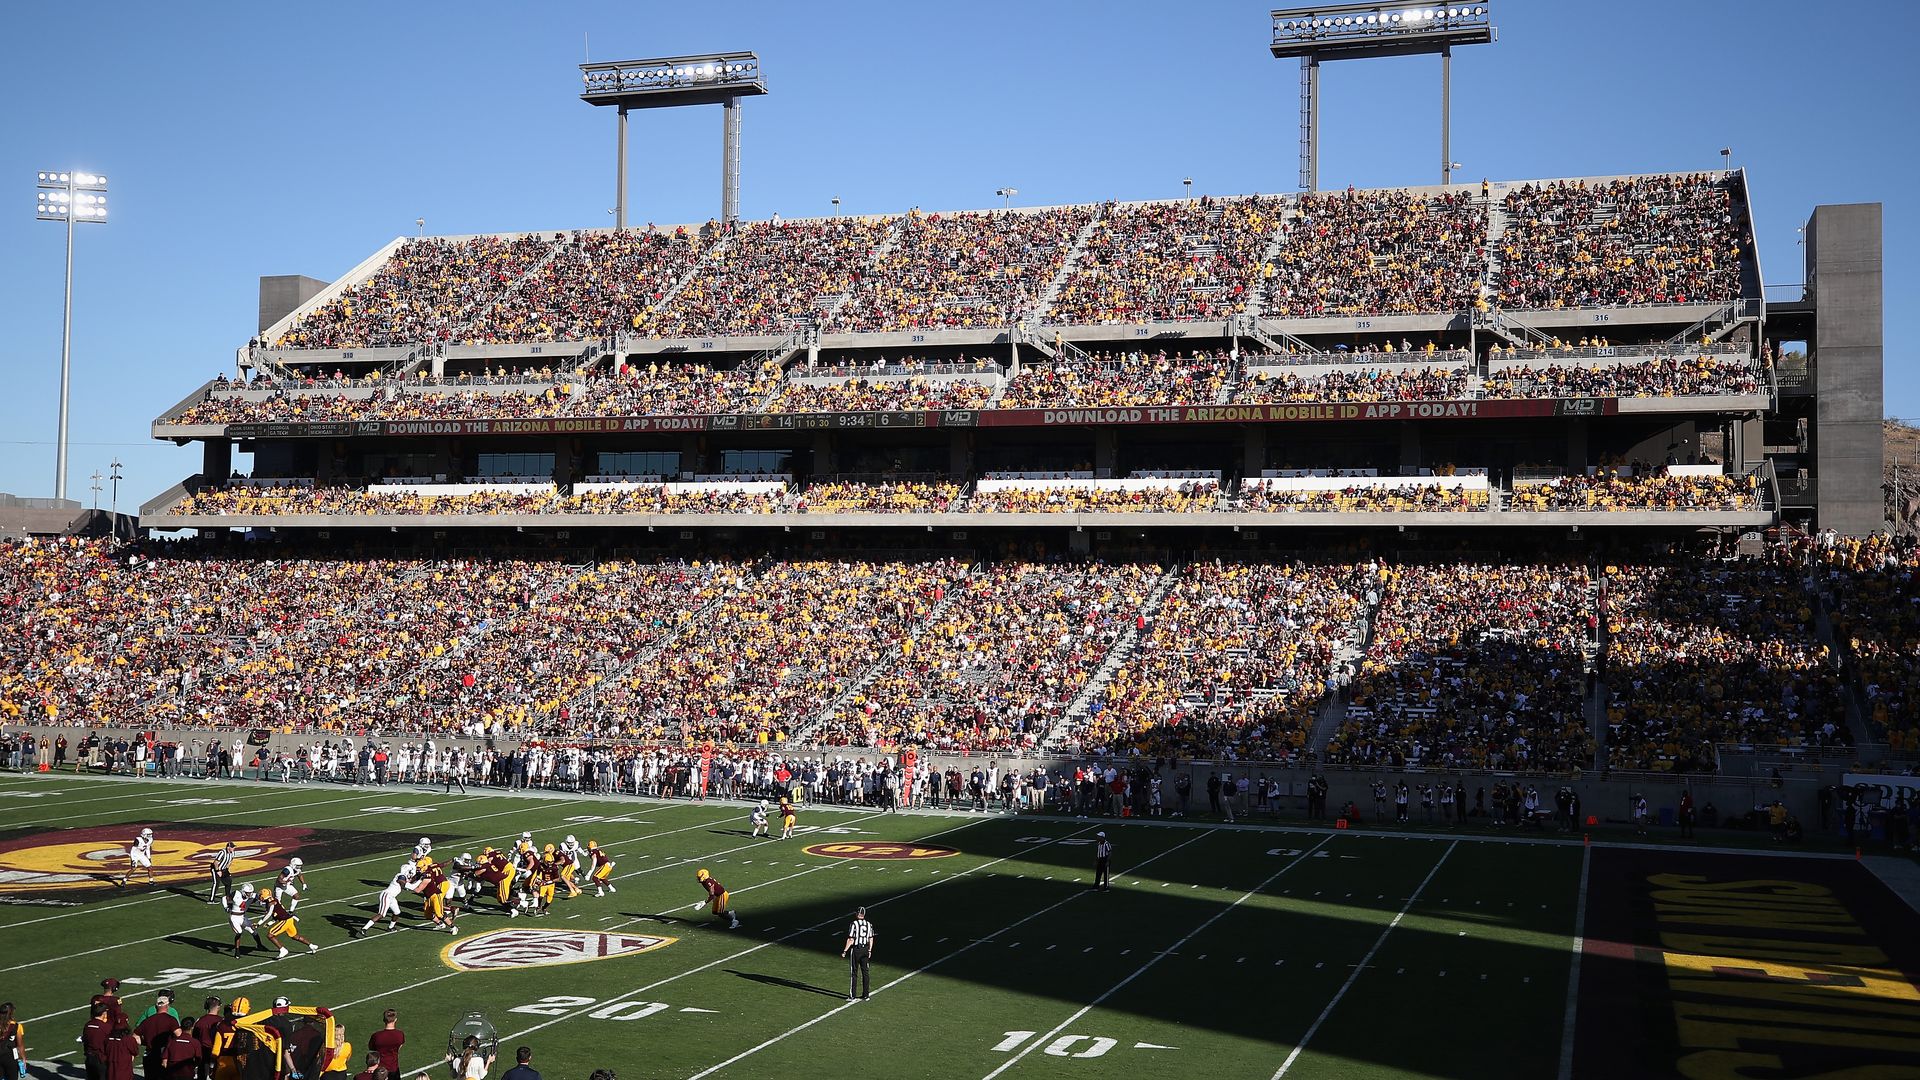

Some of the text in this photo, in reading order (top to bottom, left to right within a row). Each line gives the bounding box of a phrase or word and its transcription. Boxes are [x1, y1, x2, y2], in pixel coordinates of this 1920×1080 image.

[839, 415, 866, 426] 9:34
[881, 414, 890, 426] 6
[1044, 402, 1477, 424] DOWNLOAD THE ARIZONA MOBILE ID APP TODAY!
[389, 418, 704, 433] DOWNLOAD THE ARIZONA MOBILE ID APP TODAY!
[778, 416, 793, 428] 14
[806, 419, 816, 428] 10
[819, 419, 829, 427] 30
[1746, 532, 1756, 540] 33
[120, 967, 278, 989] 30
[507, 996, 670, 1021] 20
[223, 1032, 235, 1049] 7
[990, 1030, 1119, 1058] 10
